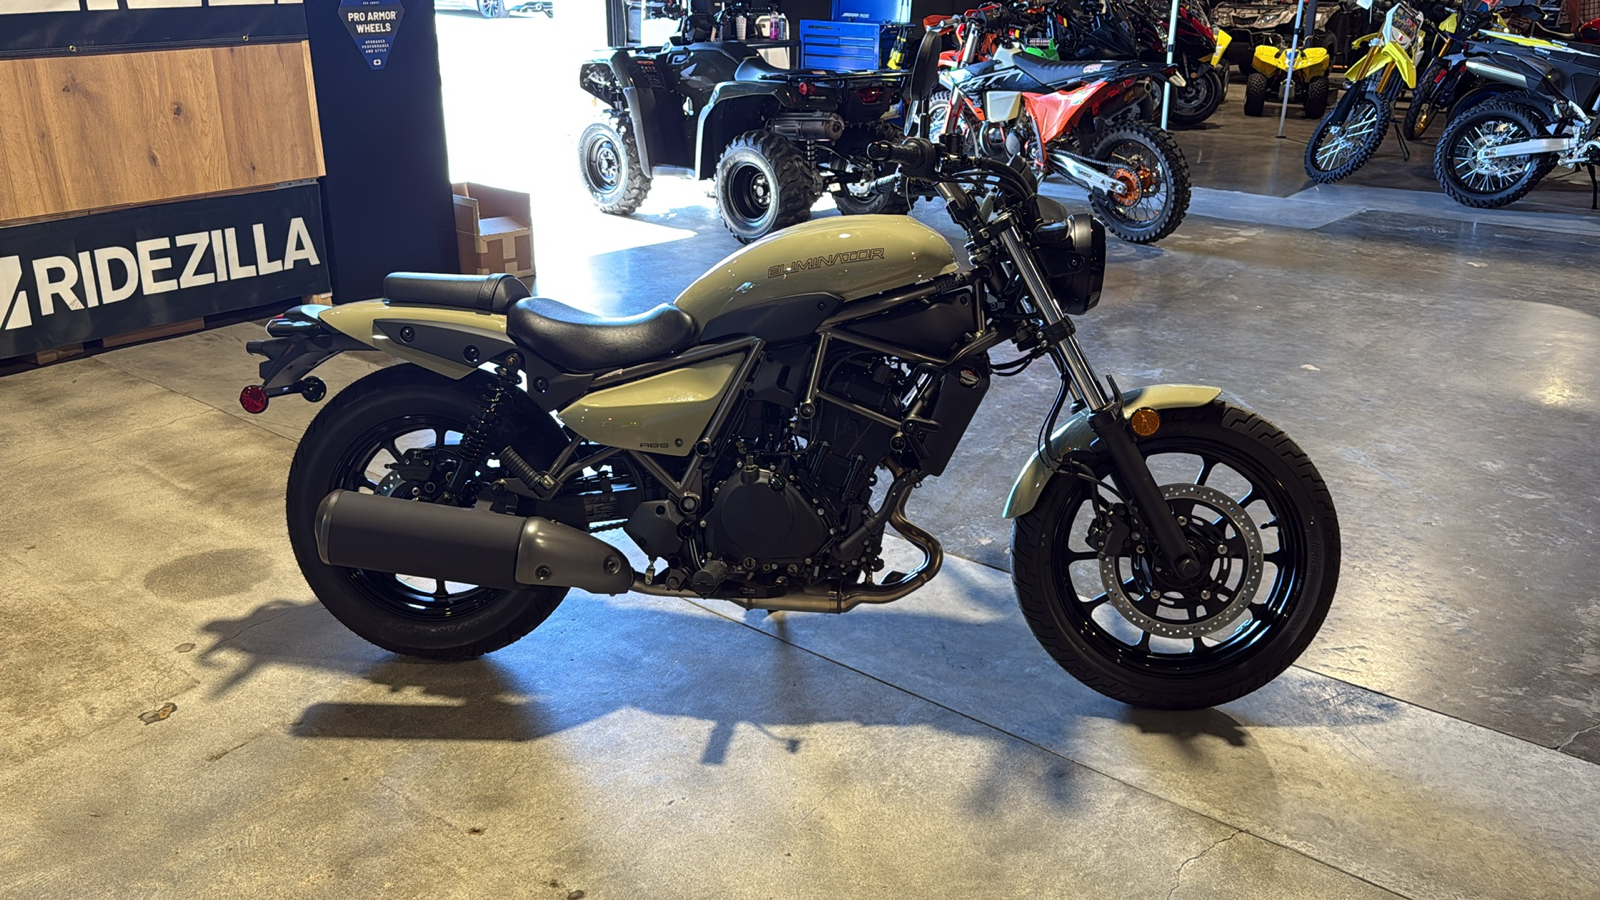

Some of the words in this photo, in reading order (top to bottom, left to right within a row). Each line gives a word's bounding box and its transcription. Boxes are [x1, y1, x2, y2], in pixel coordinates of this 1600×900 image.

[347, 12, 365, 22] PRO
[367, 11, 397, 21] ARMOR
[355, 23, 391, 33] WHEELS
[32, 217, 320, 316] RIDEZILLA
[768, 247, 885, 279] ELIMINATOR
